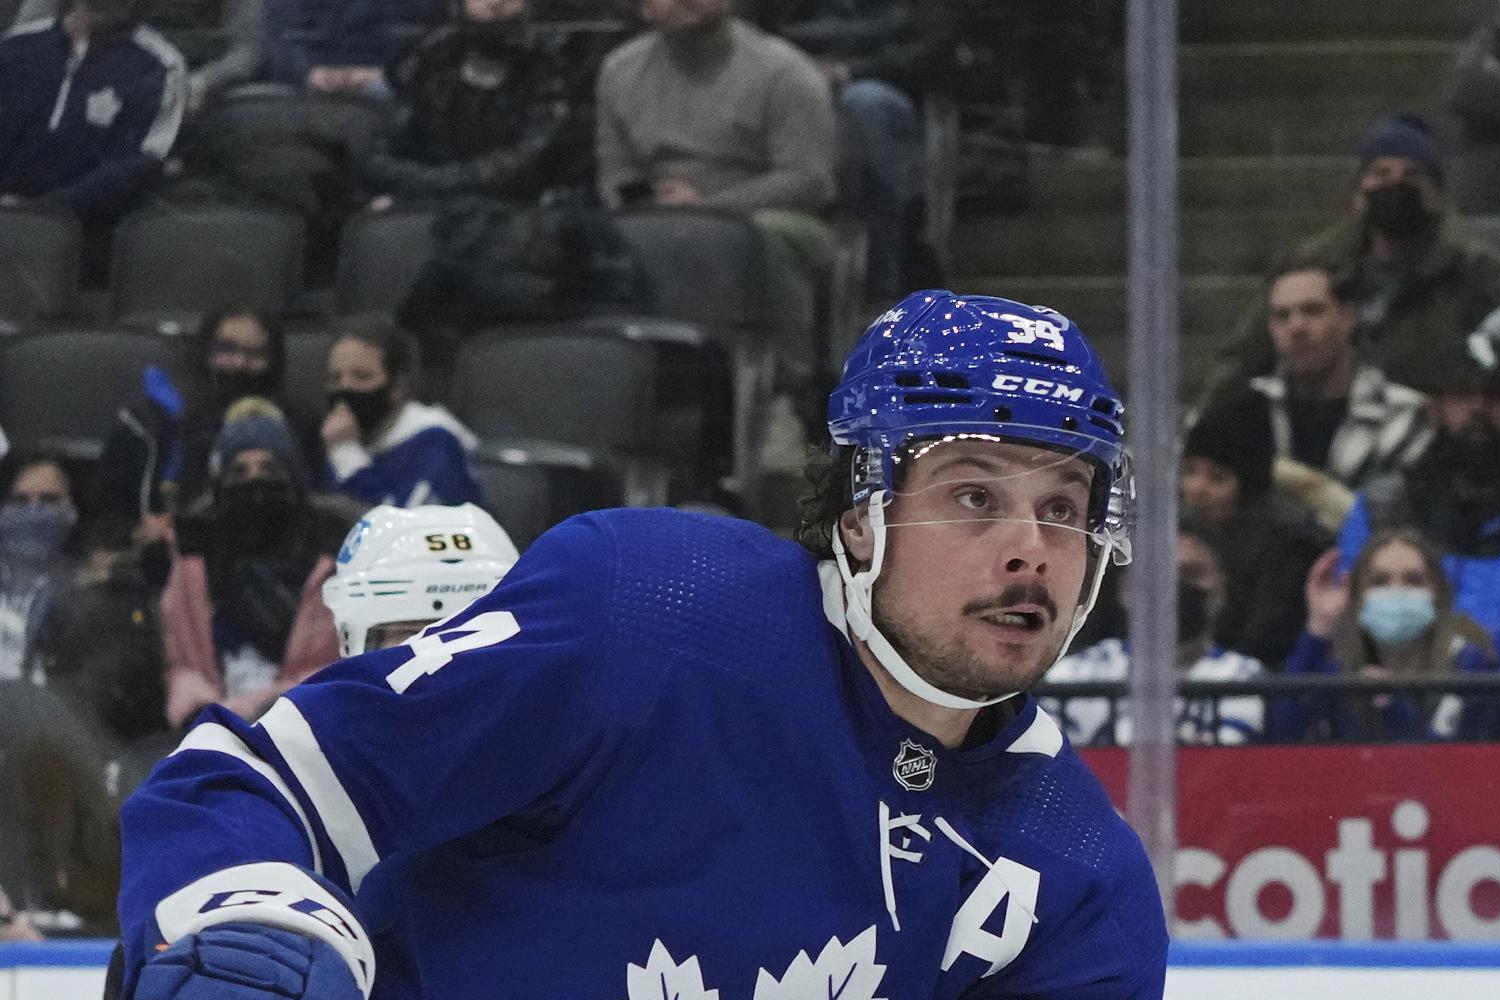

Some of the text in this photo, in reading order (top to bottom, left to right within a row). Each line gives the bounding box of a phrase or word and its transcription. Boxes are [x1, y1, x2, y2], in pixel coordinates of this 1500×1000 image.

[1007, 313, 1065, 351] 34
[991, 373, 1085, 401] CCM
[424, 533, 473, 551] 58
[385, 610, 522, 686] 4
[901, 760, 931, 776] NHL
[940, 856, 1041, 979] A
